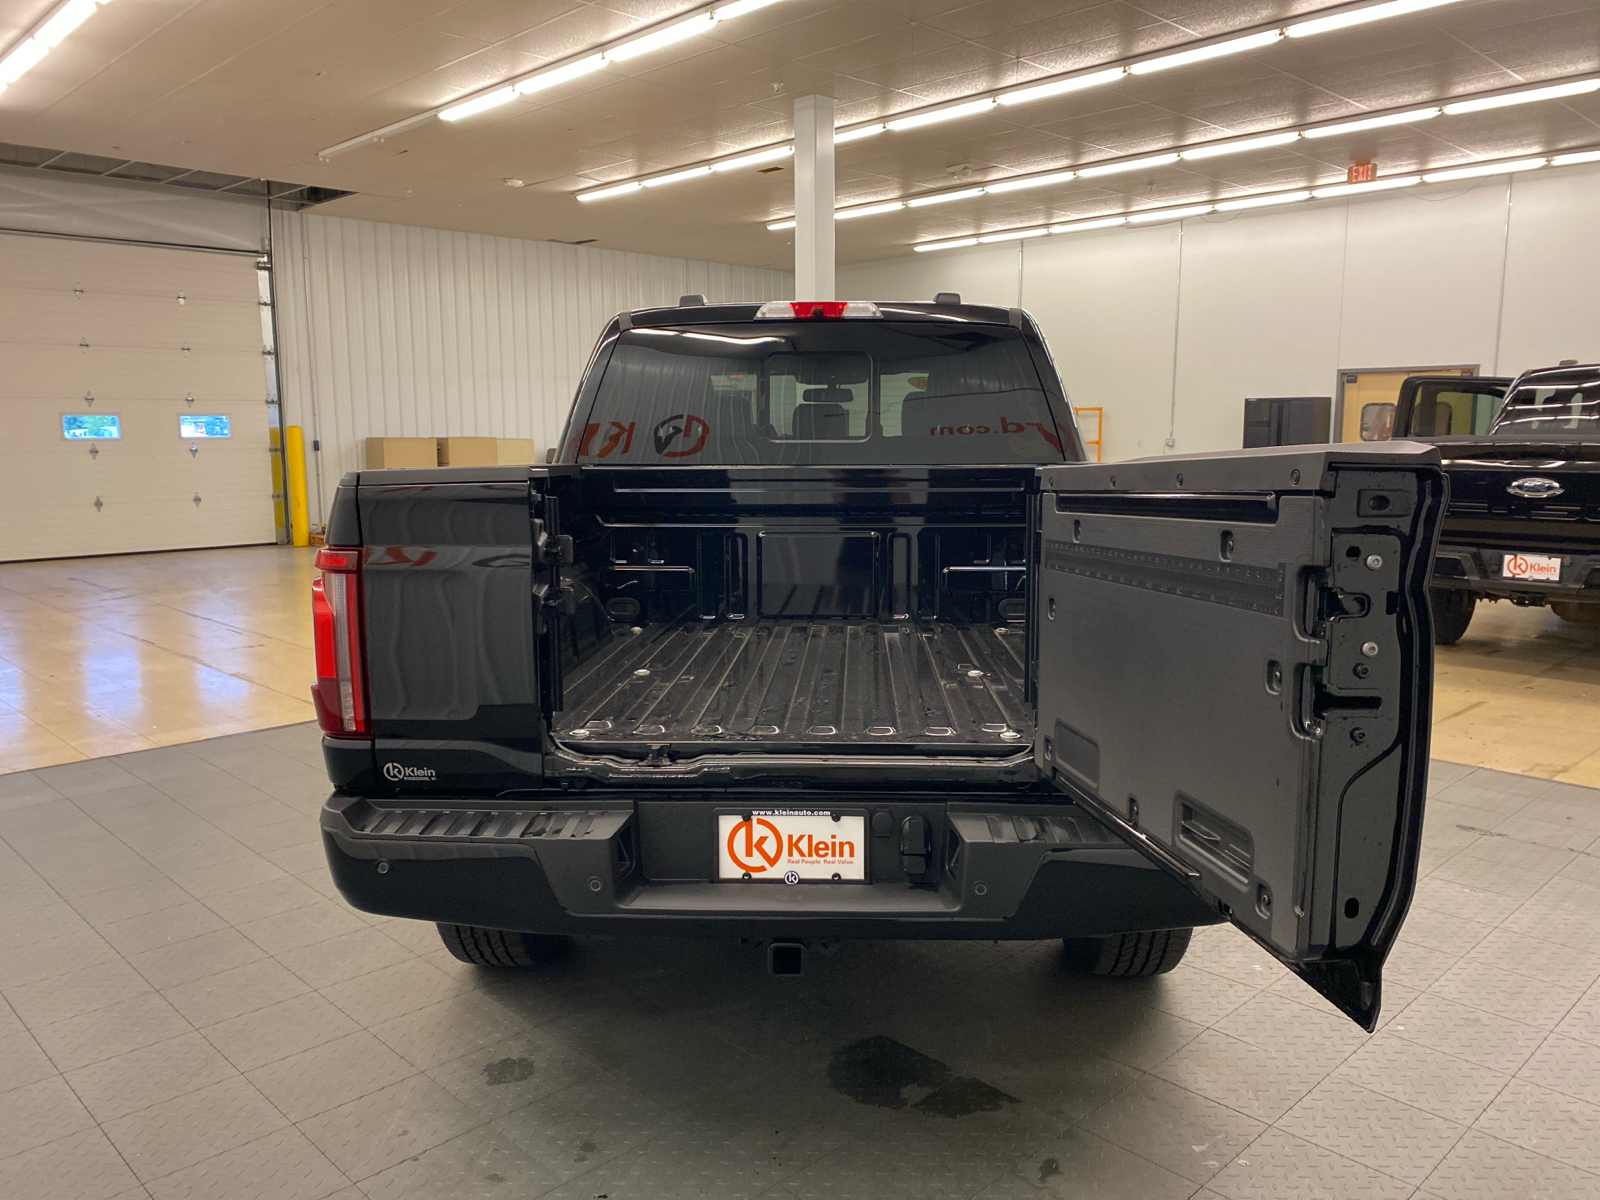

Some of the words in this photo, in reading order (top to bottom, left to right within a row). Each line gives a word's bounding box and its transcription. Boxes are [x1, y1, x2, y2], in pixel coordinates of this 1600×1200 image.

[1352, 164, 1373, 182] EXIT
[1529, 562, 1556, 573] Klein
[404, 767, 436, 777] Klein
[787, 834, 855, 858] Klein
